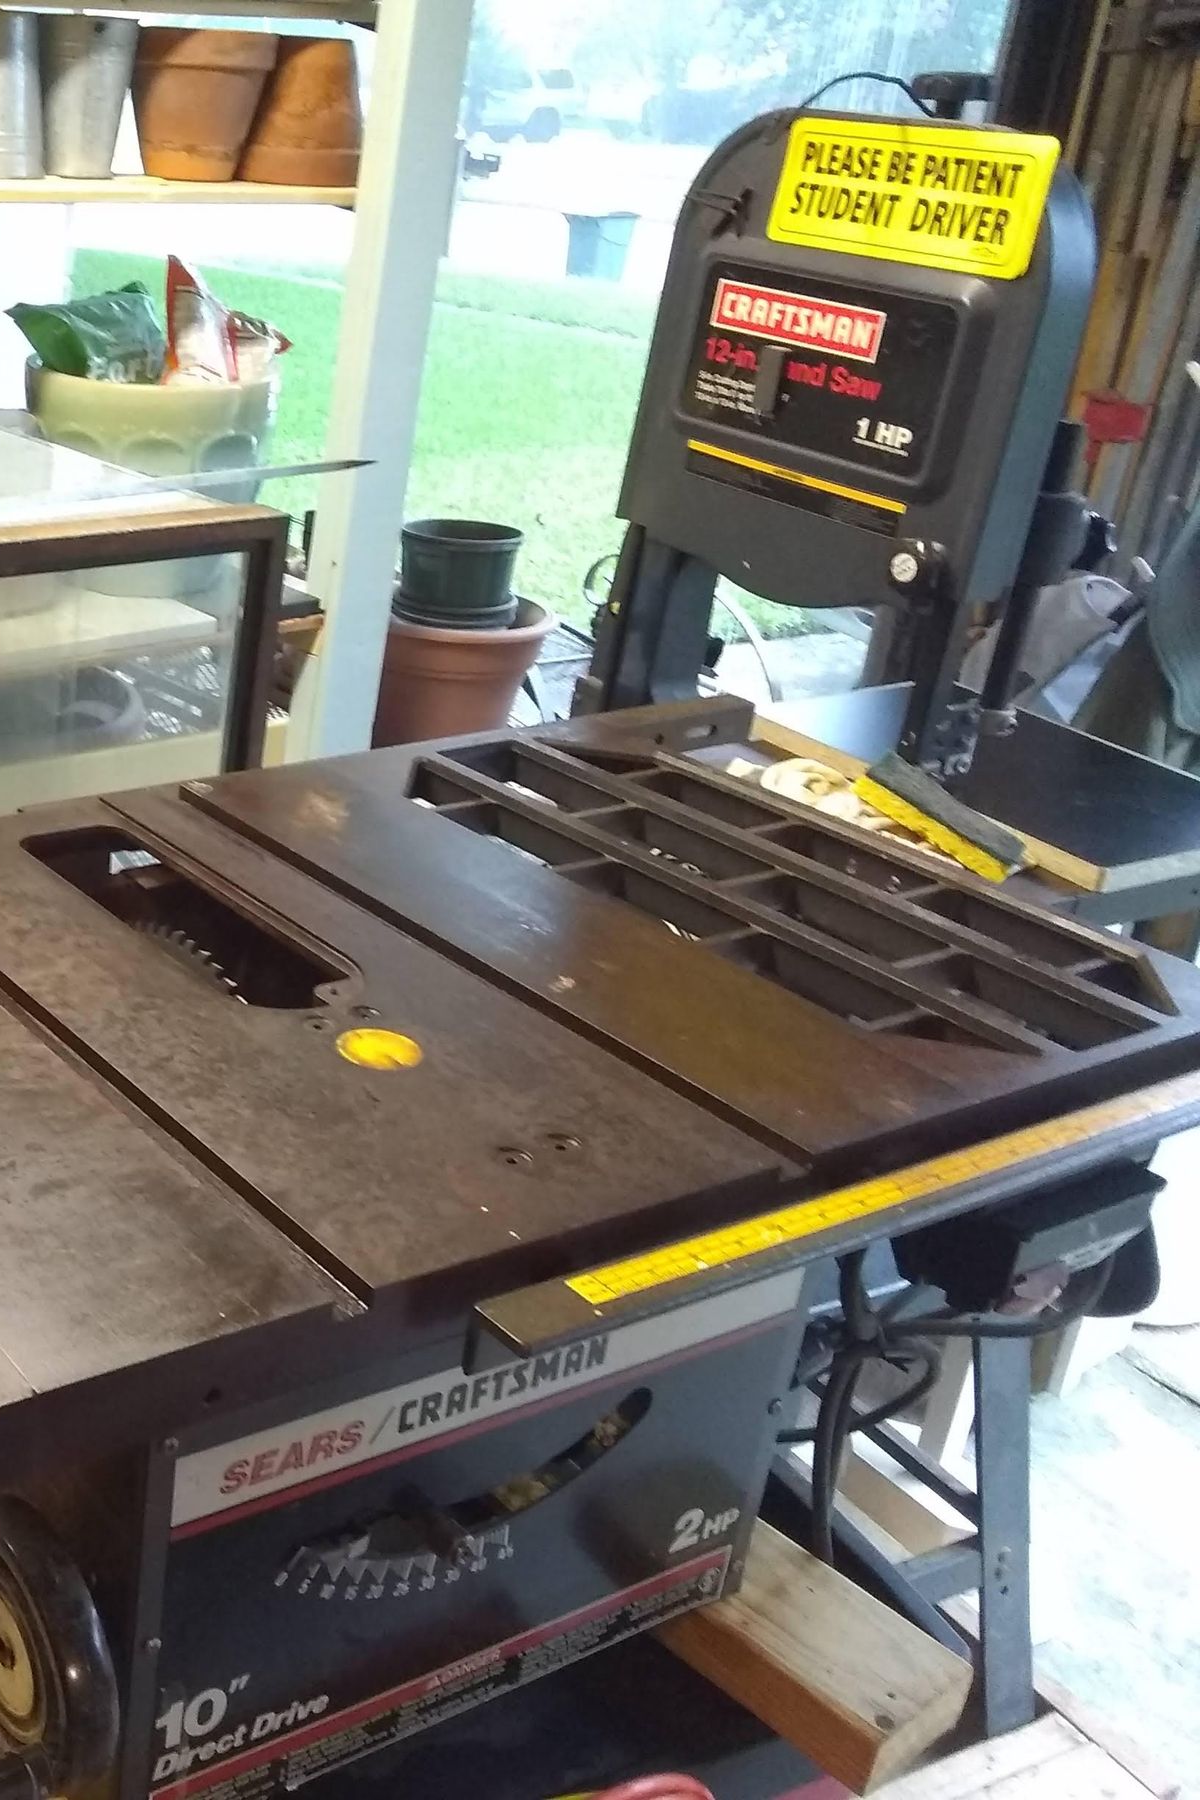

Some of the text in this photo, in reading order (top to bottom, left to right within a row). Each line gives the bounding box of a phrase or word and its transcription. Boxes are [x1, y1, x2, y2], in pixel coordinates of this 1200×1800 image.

[801, 141, 1025, 199] PLEASE BE PATIENT
[789, 181, 1012, 246] STUDENT DRIVER
[720, 291, 875, 350] CRAFTSMAN
[829, 365, 883, 401] Saw
[856, 416, 914, 448] 1 HP
[220, 1420, 365, 1494] SEARS
[397, 1335, 609, 1434] CRAFTSMAN
[668, 1508, 740, 1554] 2 HP
[152, 1724, 247, 1782] Direct
[250, 1694, 330, 1741] Drive
